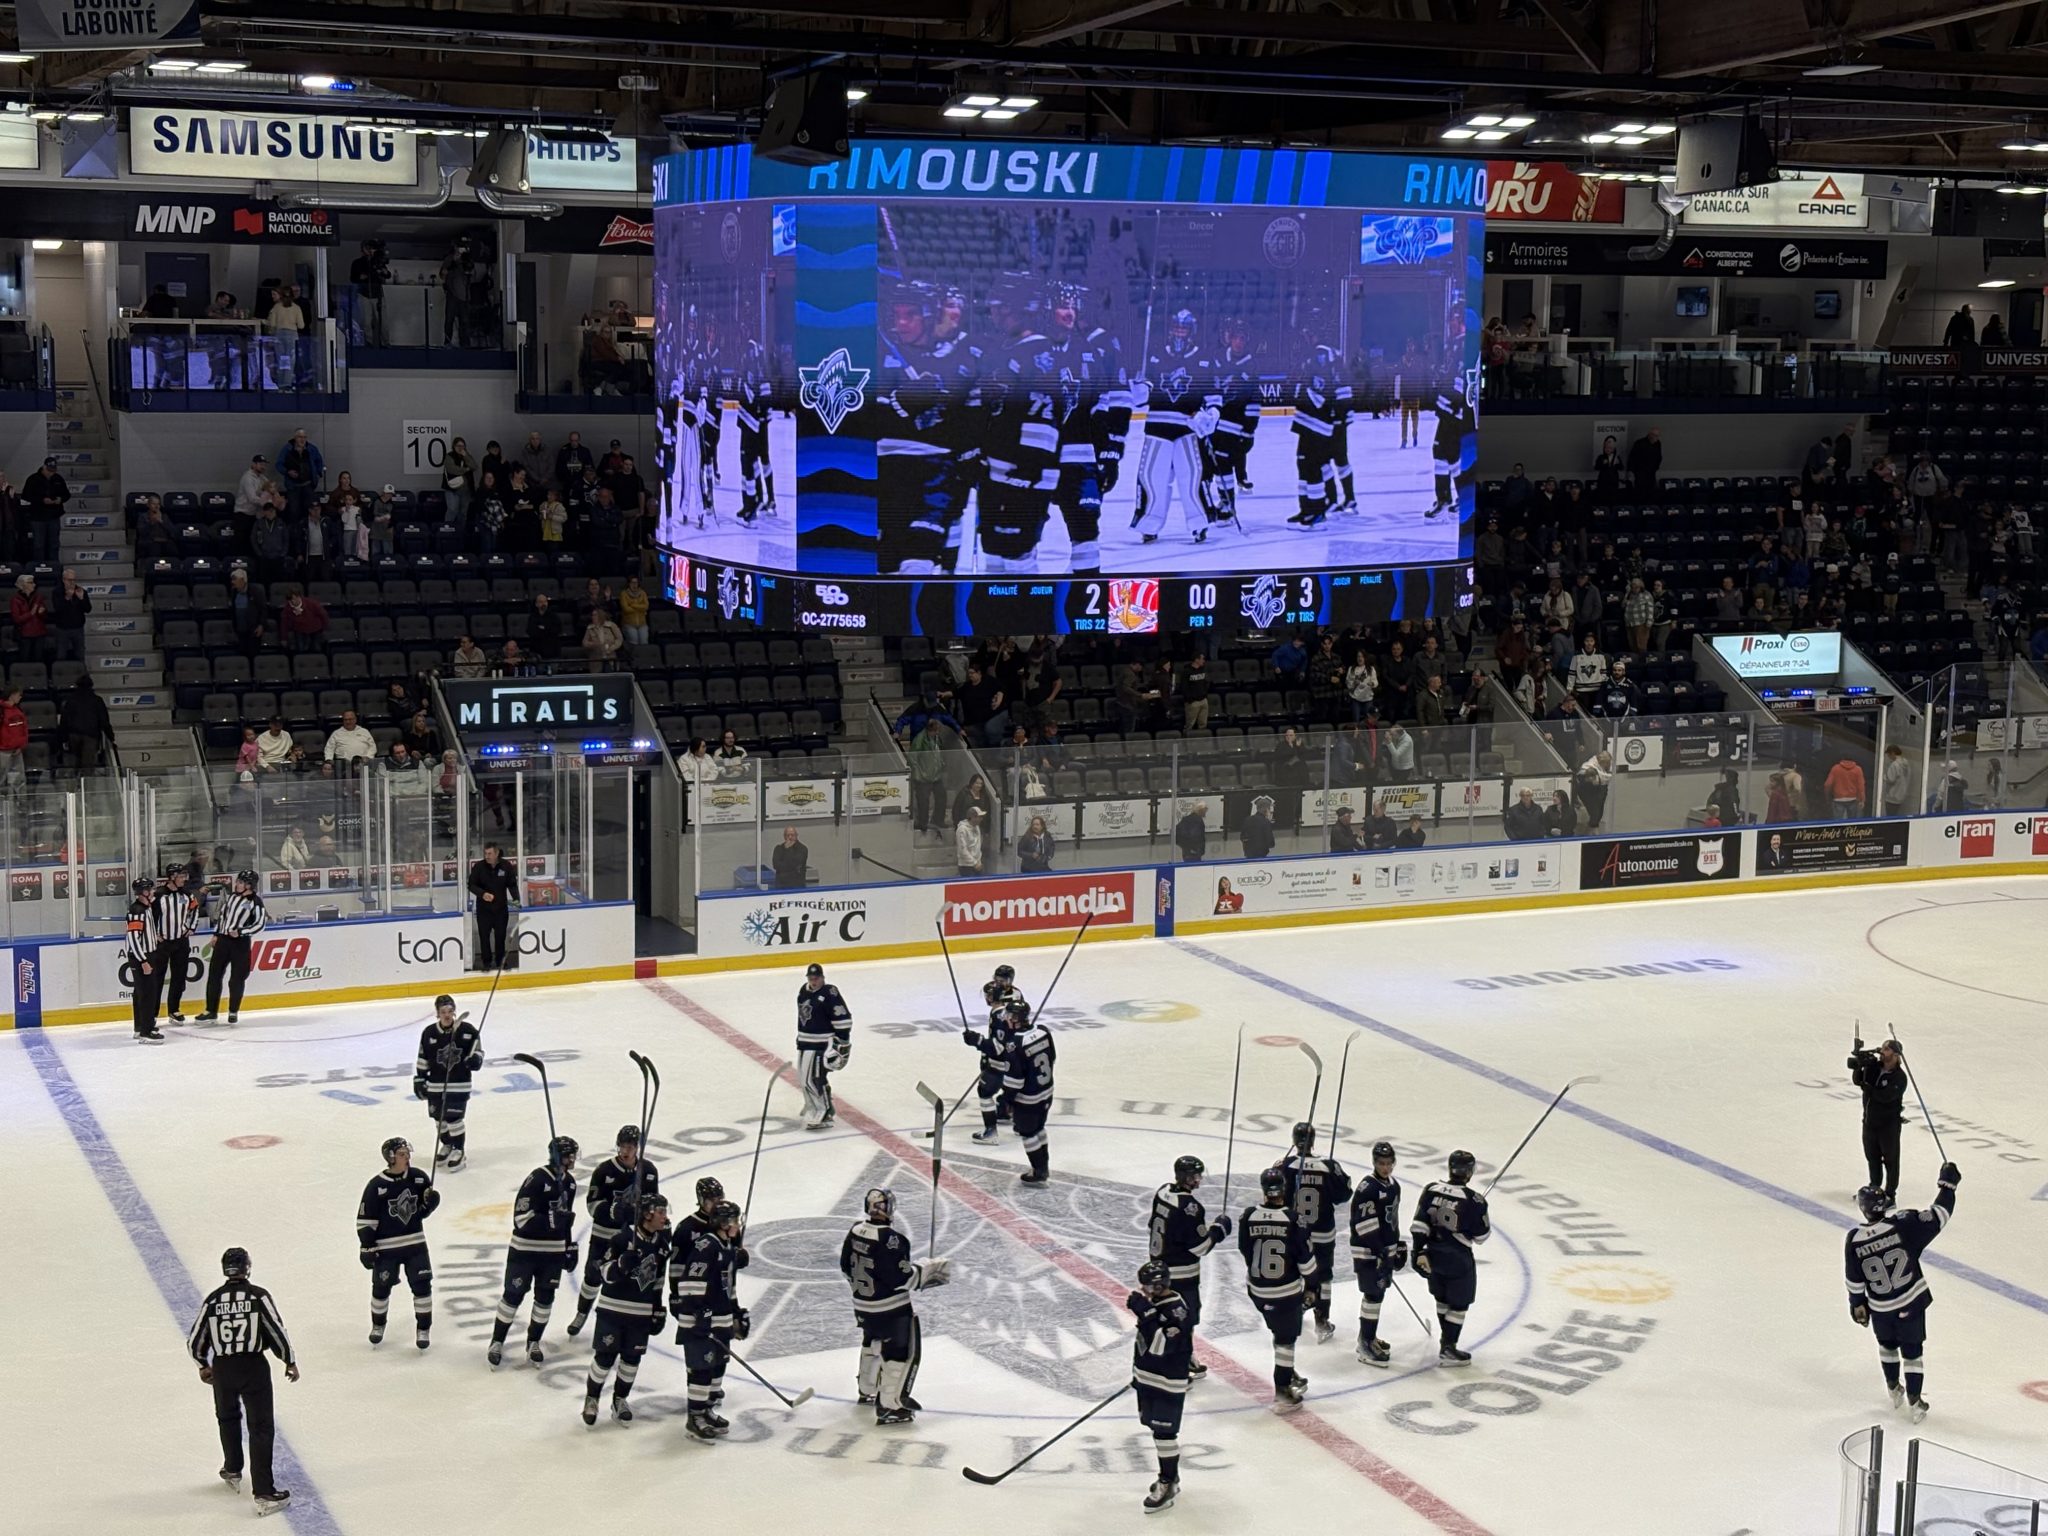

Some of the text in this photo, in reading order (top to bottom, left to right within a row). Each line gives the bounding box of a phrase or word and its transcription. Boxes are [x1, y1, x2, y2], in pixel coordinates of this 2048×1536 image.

[62, 3, 158, 36] LABONTÉ
[153, 115, 395, 163] SAMSUNG
[527, 134, 622, 163] PHILIPS
[1693, 200, 1750, 214] CANAC.CA
[1798, 203, 1857, 216] CANAC
[135, 204, 217, 234] MNP
[268, 211, 317, 225] BANQU
[268, 223, 333, 236] NATIONALE
[1508, 241, 1569, 257] Armoires
[1705, 250, 1754, 259] CONSTRUCTION
[1514, 258, 1569, 267] DISTINCTION
[406, 425, 448, 435] SECTION
[1595, 424, 1627, 434] SECTION
[406, 437, 448, 469] 10
[988, 584, 1054, 596] PÉNALITÉ JOUEUR
[1188, 583, 1216, 610] 0.0
[1299, 576, 1313, 608] 3
[1085, 583, 1101, 615] 2
[801, 611, 867, 628] OC-2775658
[1189, 614, 1213, 627] PER 3
[1286, 610, 1315, 624] 37 TIRS
[1074, 618, 1106, 631] TIRS 22
[1753, 639, 1784, 650] Proxi
[1739, 659, 1810, 670] DÉPANNEUR 7-24
[460, 697, 618, 725] MIRALIS
[141, 752, 151, 763] D
[1944, 820, 1994, 839] elran
[1703, 854, 1718, 863] 911
[12, 875, 41, 884] ROMA
[55, 872, 83, 881] ROA
[97, 870, 125, 879] ROMA
[769, 899, 866, 912] RÉFRIGÉRATION
[951, 886, 1126, 923] normandin
[765, 909, 867, 946] Air C
[285, 966, 323, 979] extra
[1453, 957, 1742, 991] SAMSUNG
[1250, 1238, 1286, 1280] 16
[688, 1261, 709, 1277] 27
[1861, 1247, 1914, 1295] 92
[215, 1299, 252, 1316] GIRARD
[219, 1318, 248, 1343] 67
